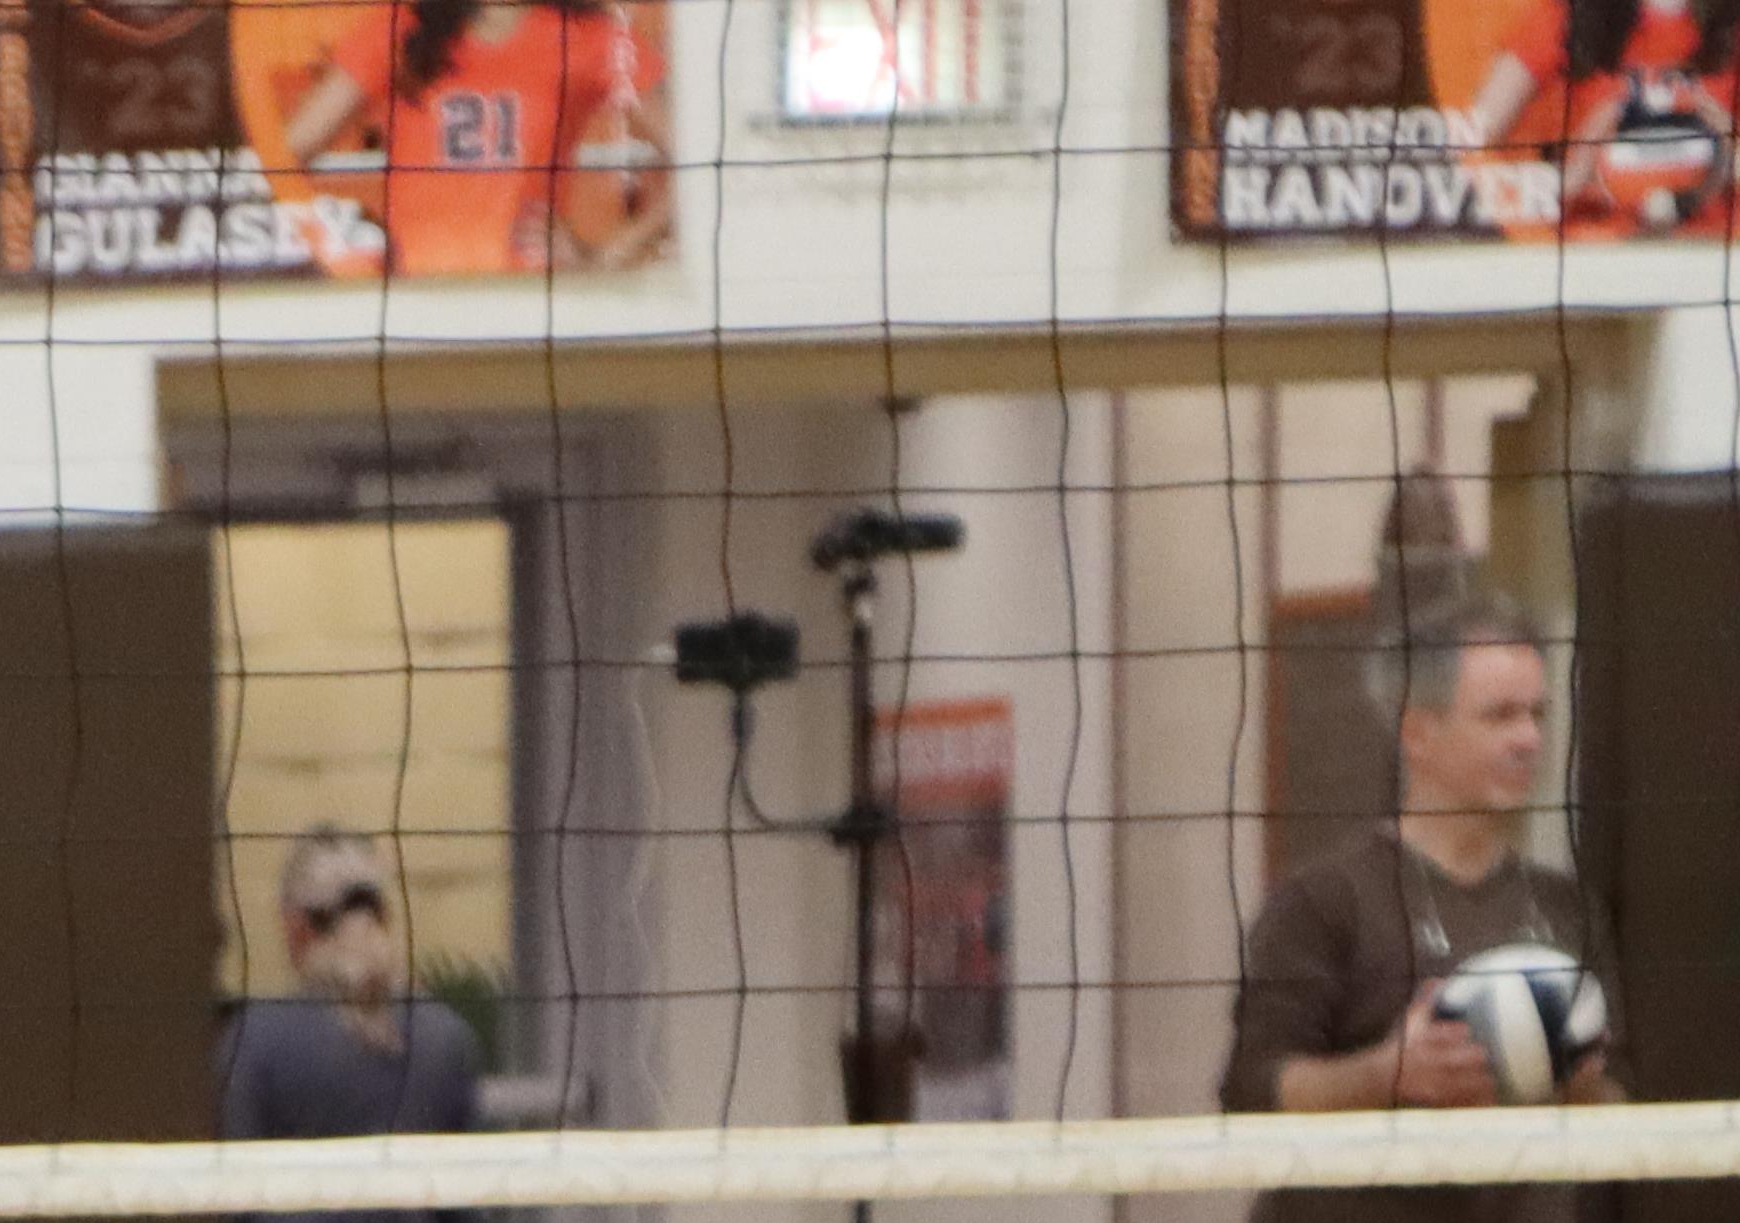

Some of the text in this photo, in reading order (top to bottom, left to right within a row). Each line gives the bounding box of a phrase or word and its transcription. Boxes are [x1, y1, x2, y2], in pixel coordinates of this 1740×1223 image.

[439, 89, 522, 167] 21
[1224, 107, 1488, 162] MADISON
[1222, 160, 1562, 230] HANOVER
